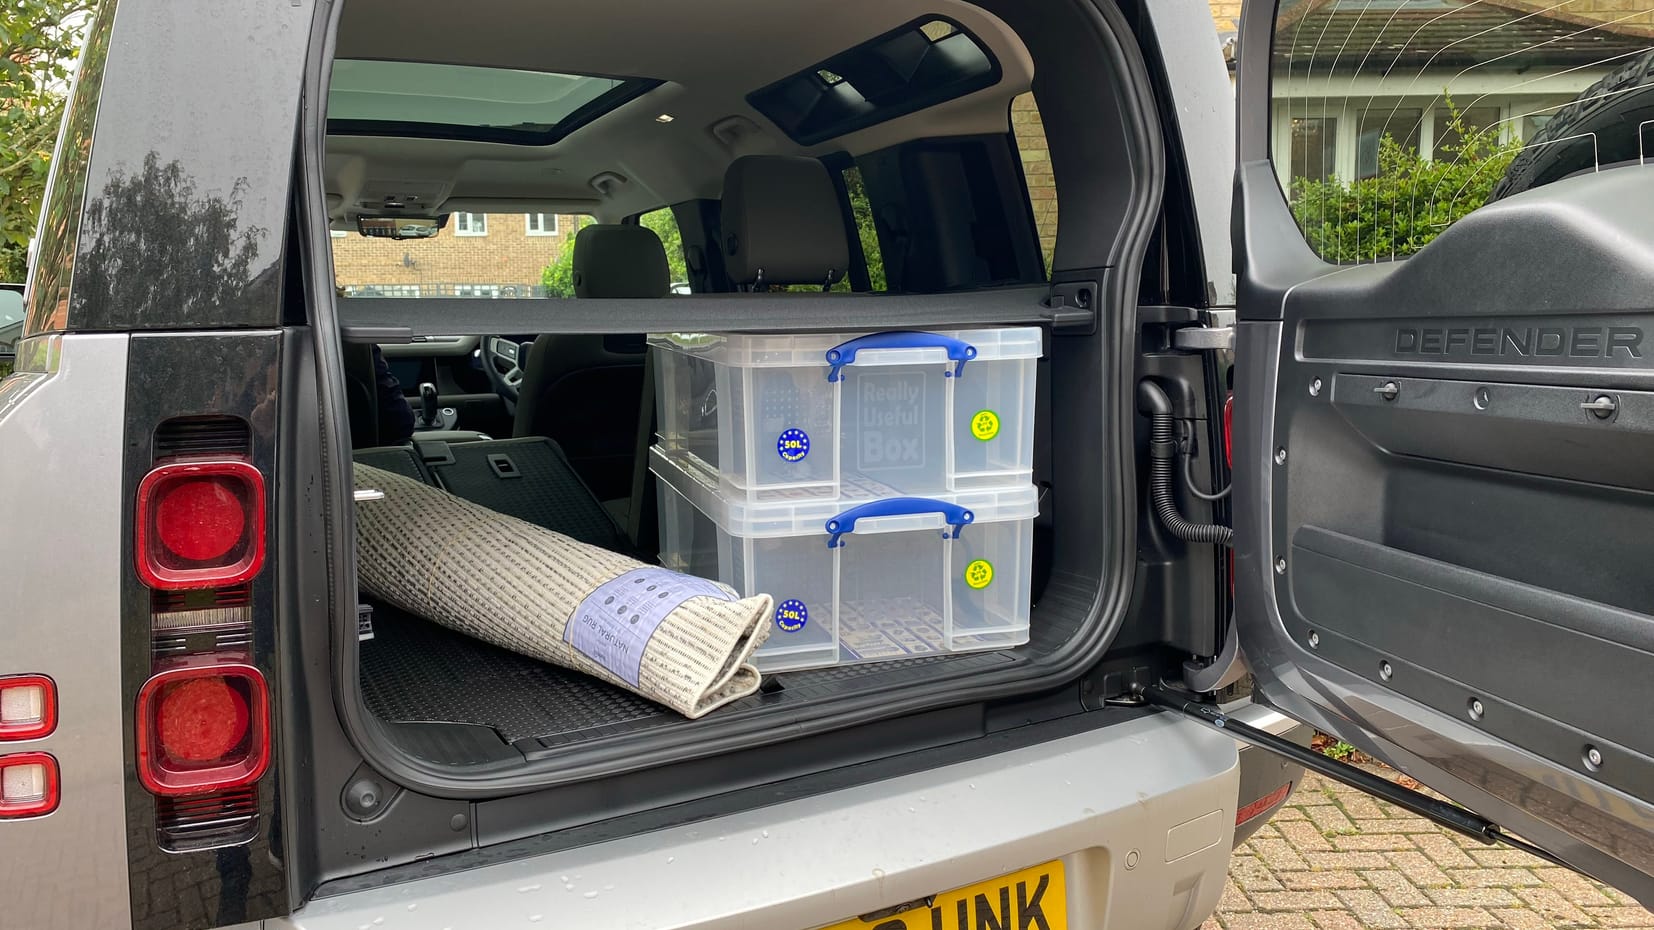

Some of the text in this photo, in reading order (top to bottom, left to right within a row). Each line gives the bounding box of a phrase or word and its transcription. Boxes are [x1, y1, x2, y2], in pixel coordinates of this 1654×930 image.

[1395, 327, 1644, 358] DEFENDER
[863, 381, 919, 404] Really
[863, 405, 919, 427] Useful
[785, 440, 803, 449] 50L
[863, 431, 919, 463] Box
[782, 451, 805, 461] Capacity
[582, 614, 598, 630] RUG
[783, 610, 800, 620] 50L
[779, 621, 801, 631] Capacity
[599, 625, 629, 654] NATURAL
